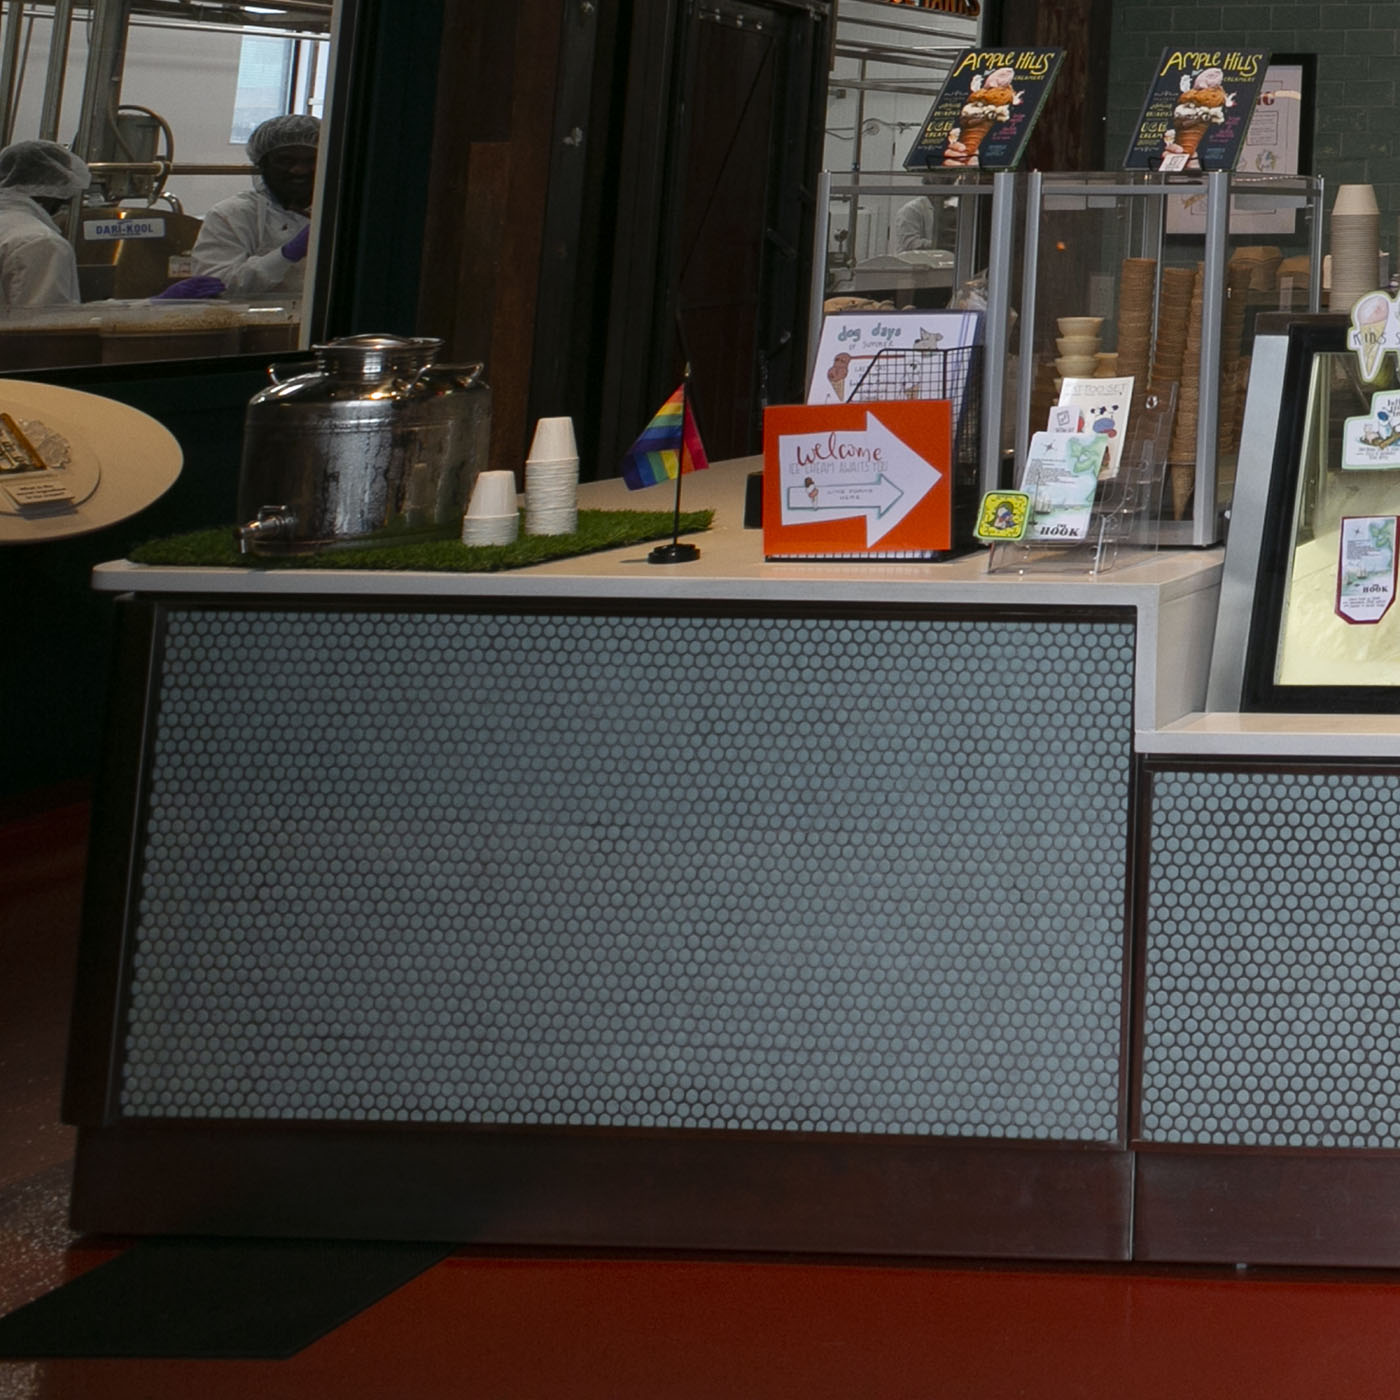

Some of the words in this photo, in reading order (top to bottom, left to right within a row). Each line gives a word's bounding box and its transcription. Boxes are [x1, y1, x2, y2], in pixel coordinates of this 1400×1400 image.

[96, 223, 154, 235] DARI-KOOL
[838, 325, 861, 342] dog
[871, 323, 901, 340] days
[796, 432, 882, 466] welcome
[805, 462, 834, 474] CREAM
[1040, 527, 1080, 537] HOOK
